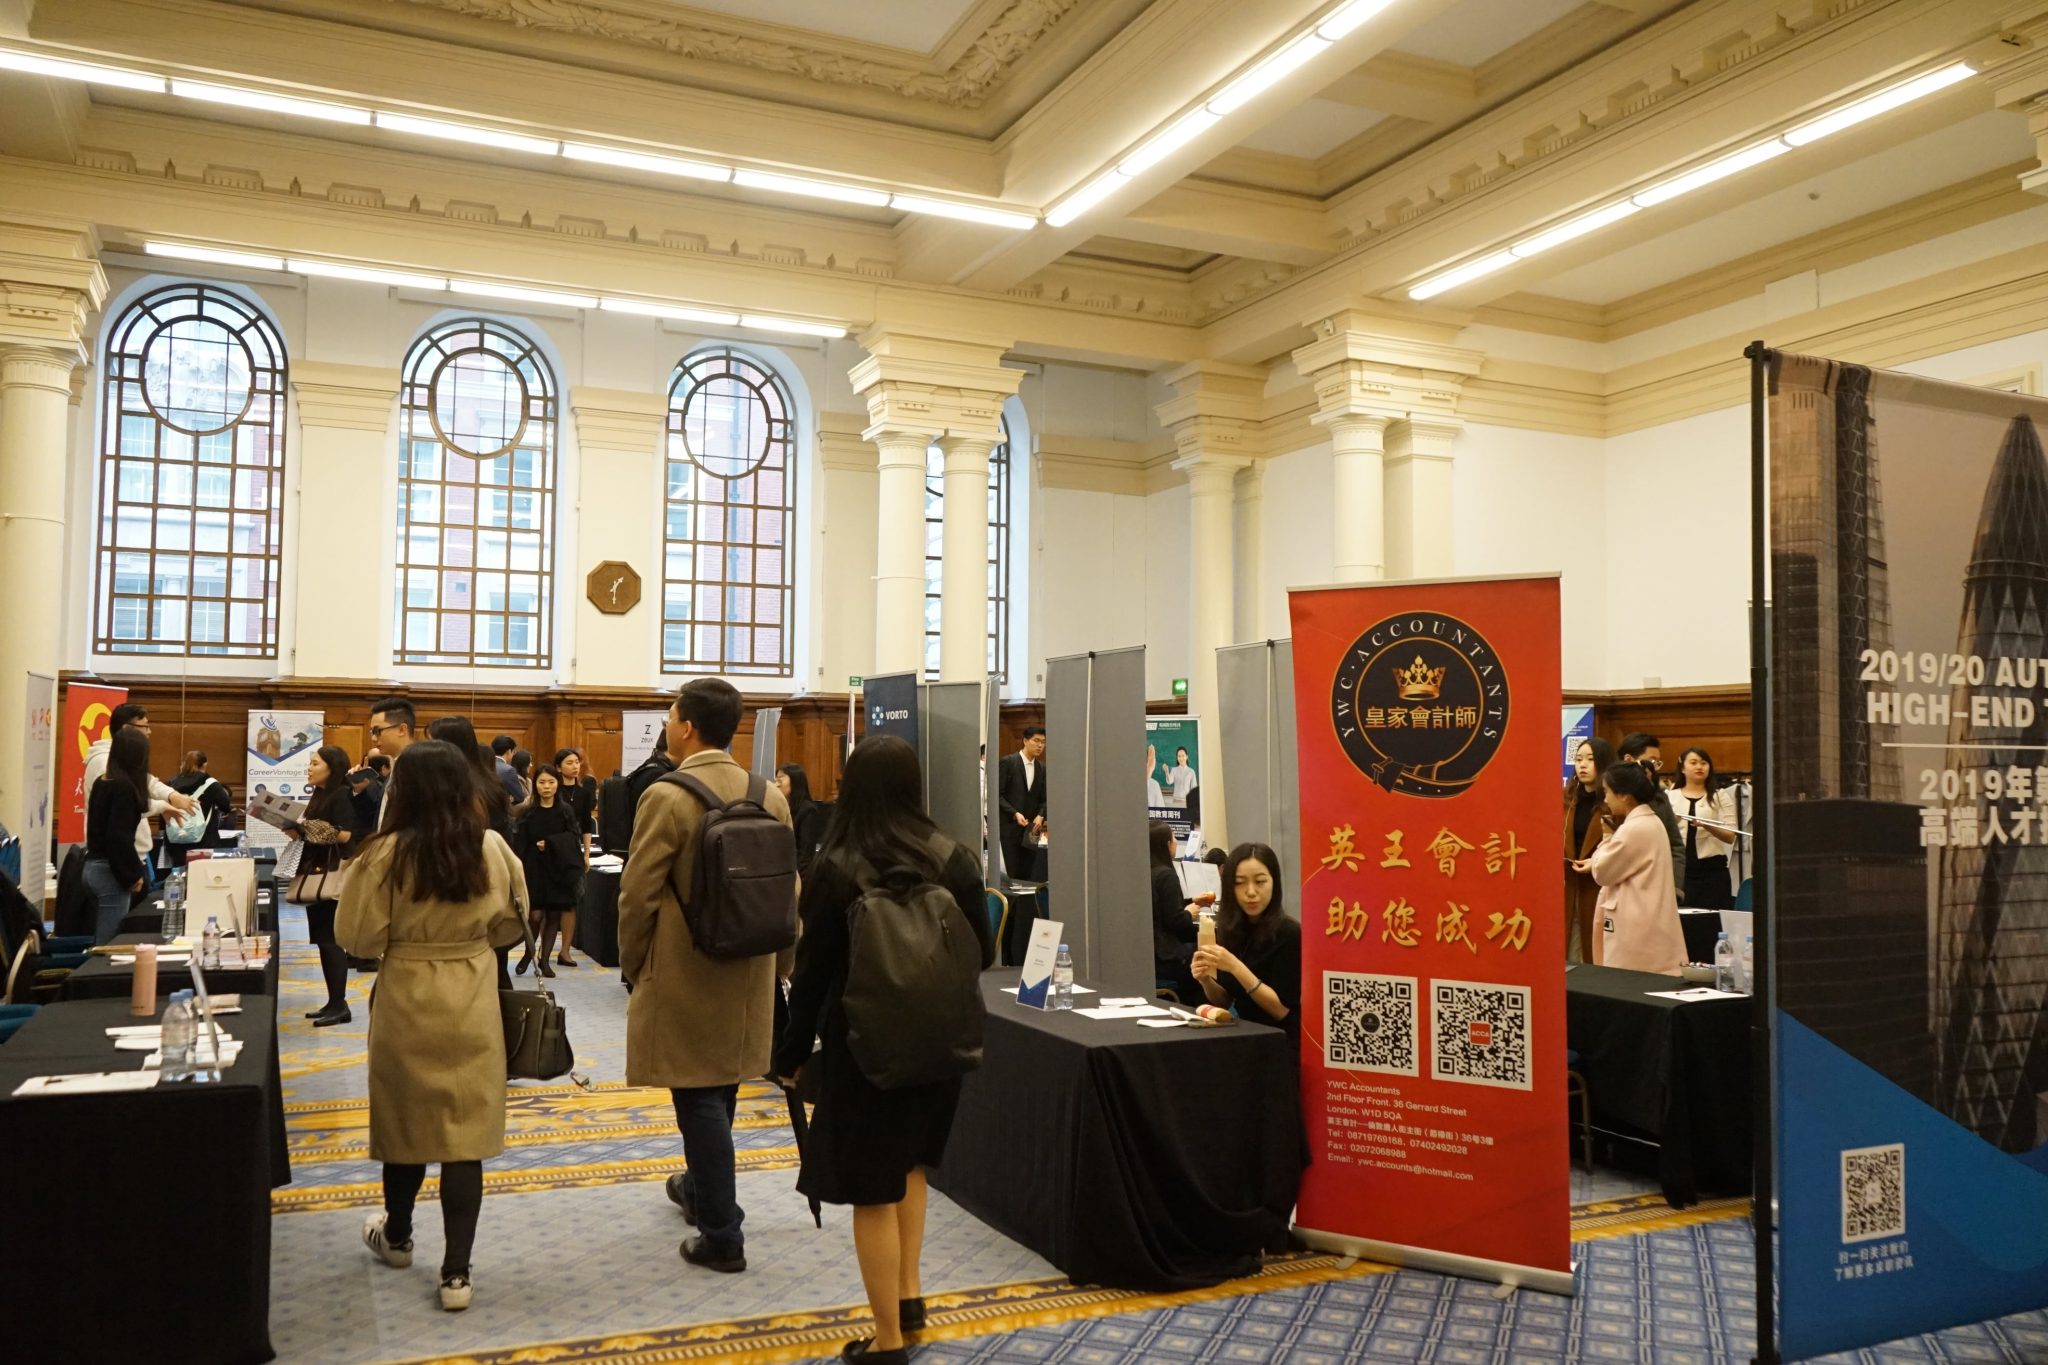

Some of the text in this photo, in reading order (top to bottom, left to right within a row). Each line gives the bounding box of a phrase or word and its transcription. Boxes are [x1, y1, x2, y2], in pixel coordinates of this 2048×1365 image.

[1356, 619, 1502, 738] ACCOUNTANTS
[1860, 649, 1985, 687] 2019/20
[885, 709, 908, 720] VORTO
[1364, 705, 1477, 729] 皇家會計師
[1867, 691, 2035, 728] HIGH-END
[645, 724, 651, 735] Z
[1321, 823, 1528, 880] 英王會計
[1325, 896, 1532, 954] 助您成功
[1327, 1080, 1400, 1095] YWC Accountants
[1327, 1092, 1342, 1101] 2nd
[1343, 1095, 1364, 1104] Floor
[1393, 1100, 1404, 1108] 36
[1405, 1101, 1438, 1113] Gerrard
[1440, 1105, 1467, 1116] Street
[1361, 1108, 1381, 1118] W1D
[1384, 1110, 1402, 1120] 5QA
[1357, 1158, 1473, 1181] ywc.accounts@hotmail.com
